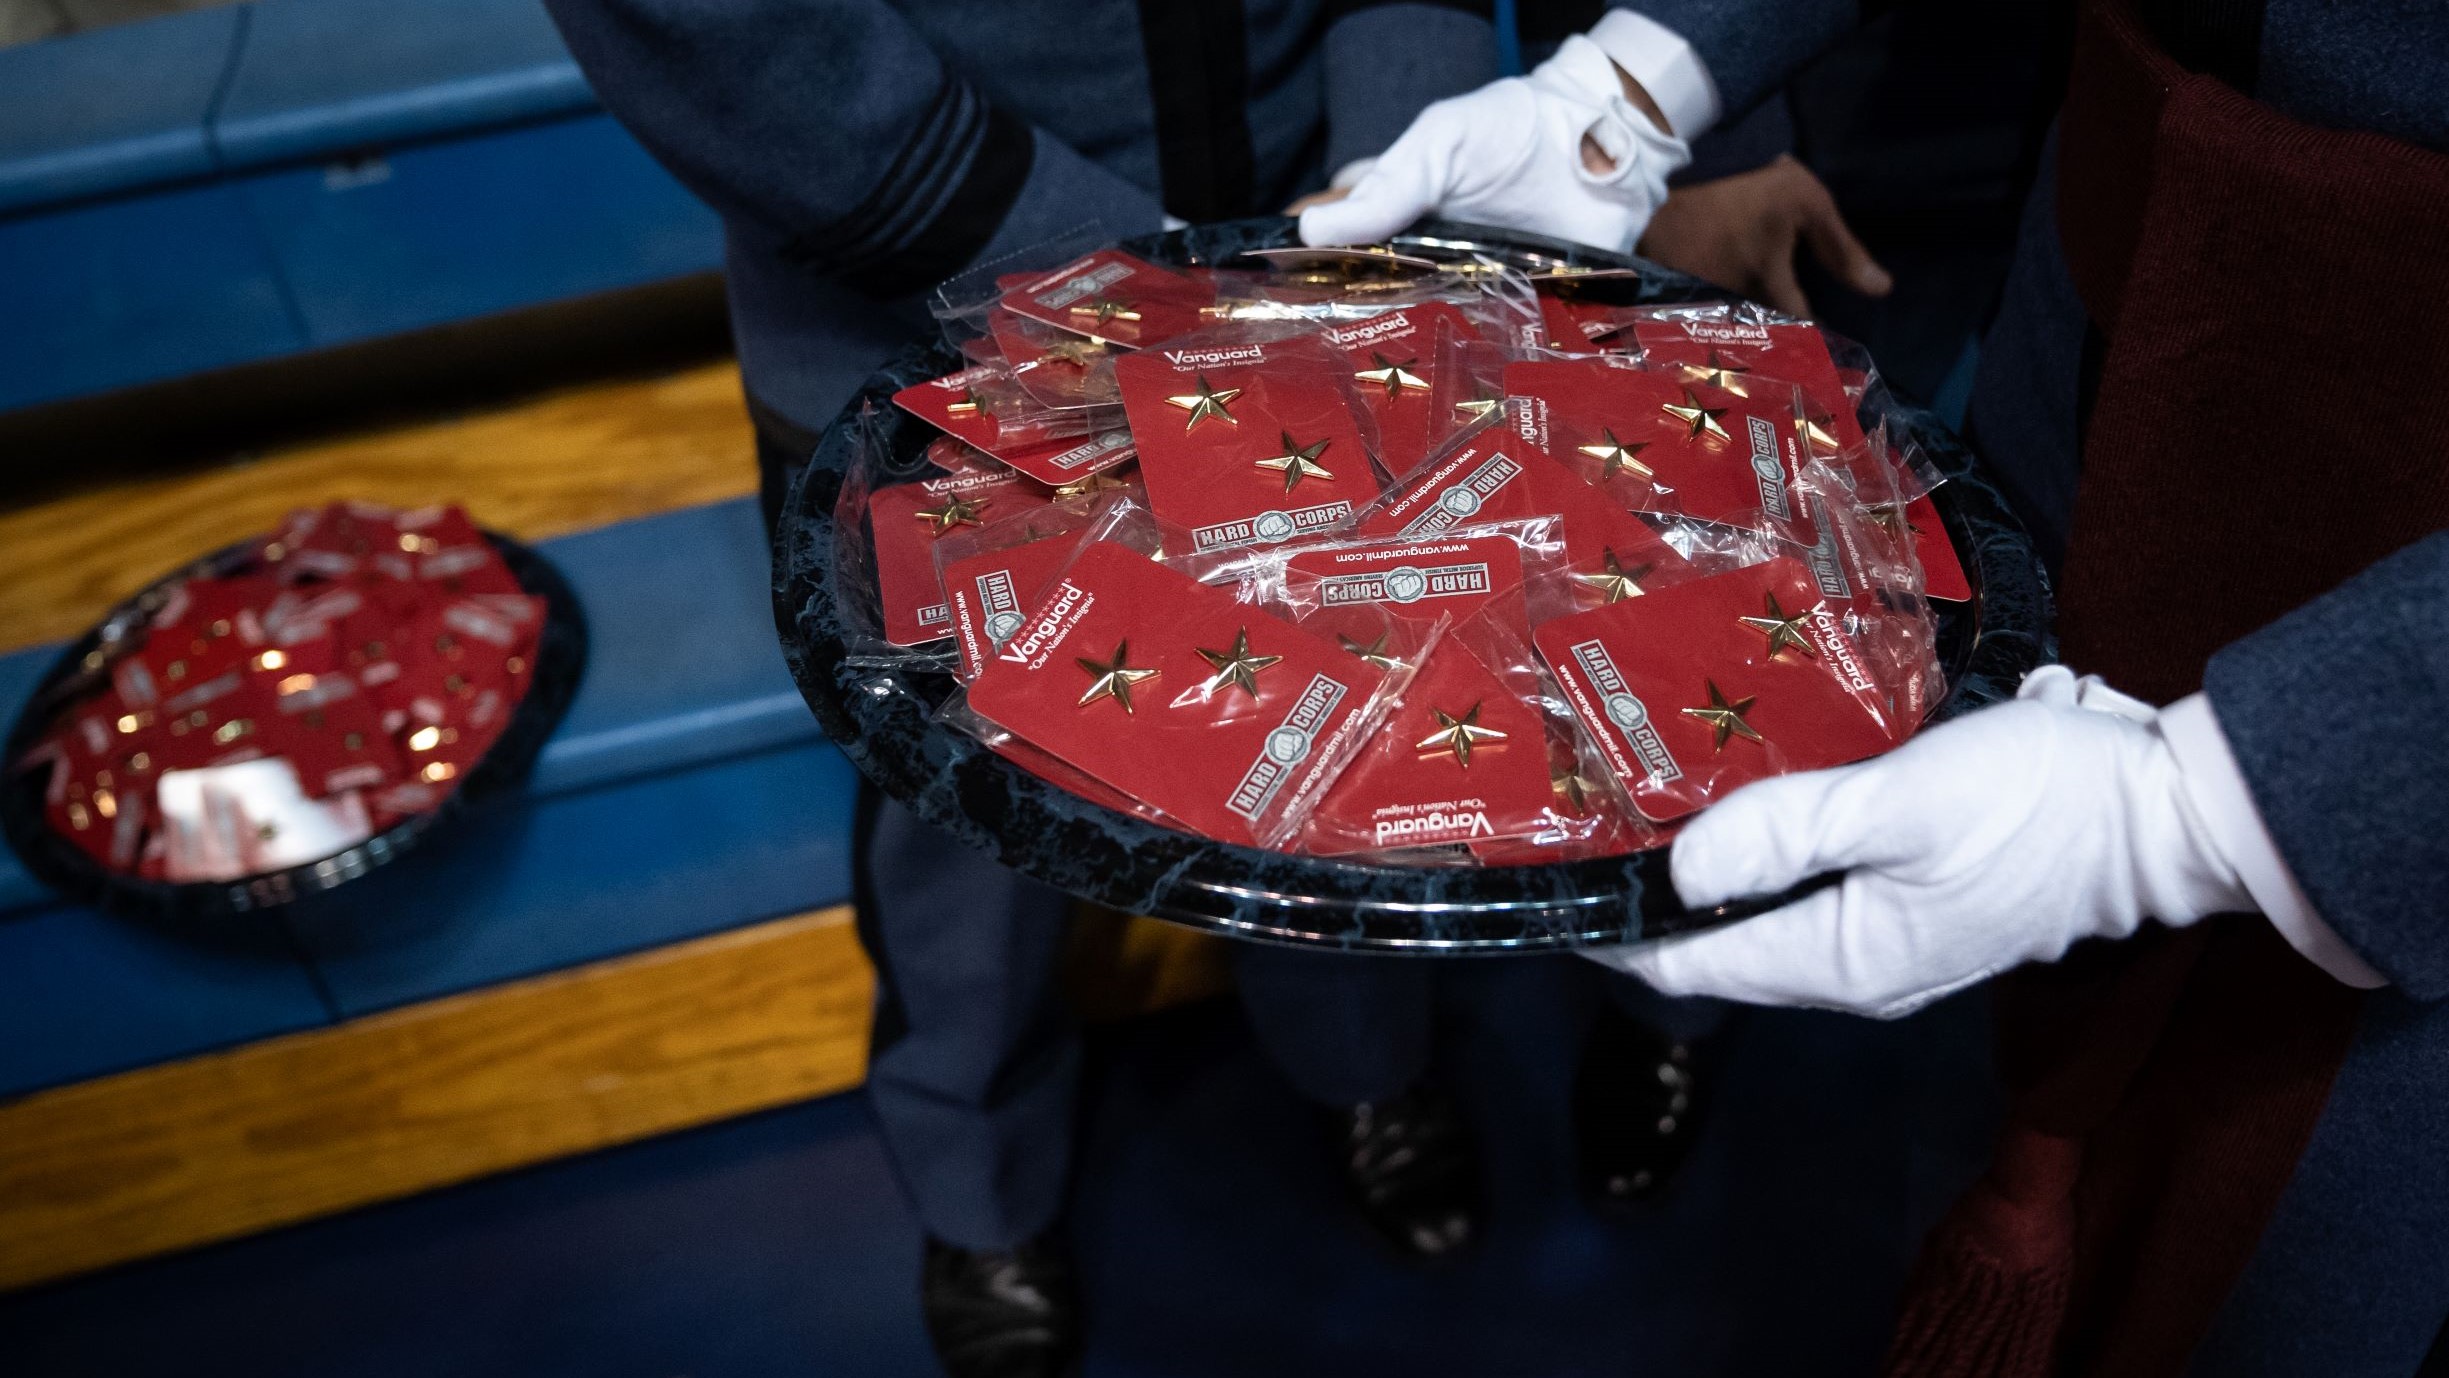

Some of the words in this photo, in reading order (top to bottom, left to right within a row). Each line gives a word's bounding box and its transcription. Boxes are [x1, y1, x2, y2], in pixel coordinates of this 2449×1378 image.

[1320, 312, 1410, 344] Vanguard
[1680, 321, 1769, 339] Vanguard
[1164, 344, 1262, 365] Vanguard
[1514, 395, 1538, 446] nguard
[1752, 420, 1770, 455] CORPS
[921, 468, 1017, 492] Vanguard
[1389, 448, 1477, 517] www.vanguardmil.com
[1474, 461, 1514, 494] HARD
[1200, 524, 1250, 546] HARD
[1295, 505, 1348, 527] CORPS
[1336, 543, 1469, 563] www.vanguardmil.com
[988, 575, 1012, 610] HARD
[1328, 581, 1383, 601] CORPS
[1431, 571, 1483, 593] HARD
[1816, 560, 1841, 593] HARD
[925, 606, 948, 620] HA
[1000, 581, 1083, 663] Vanguard
[1028, 652, 1049, 670] "Our
[1044, 624, 1073, 653] Nation's
[1068, 592, 1095, 624] Insignia"
[1810, 628, 1835, 661] Nation's
[1811, 600, 1875, 692] Vanguard
[1558, 664, 1634, 779] www.vanguardmil.com
[1583, 646, 1621, 691] HARD
[1635, 728, 1676, 779] CORPS
[1236, 762, 1277, 810] HARD
[1292, 680, 1335, 729] CORPS
[1281, 708, 1361, 820] www.vanguardmil.com
[1417, 800, 1458, 815] Nation's
[1376, 811, 1495, 846] Vanguard
